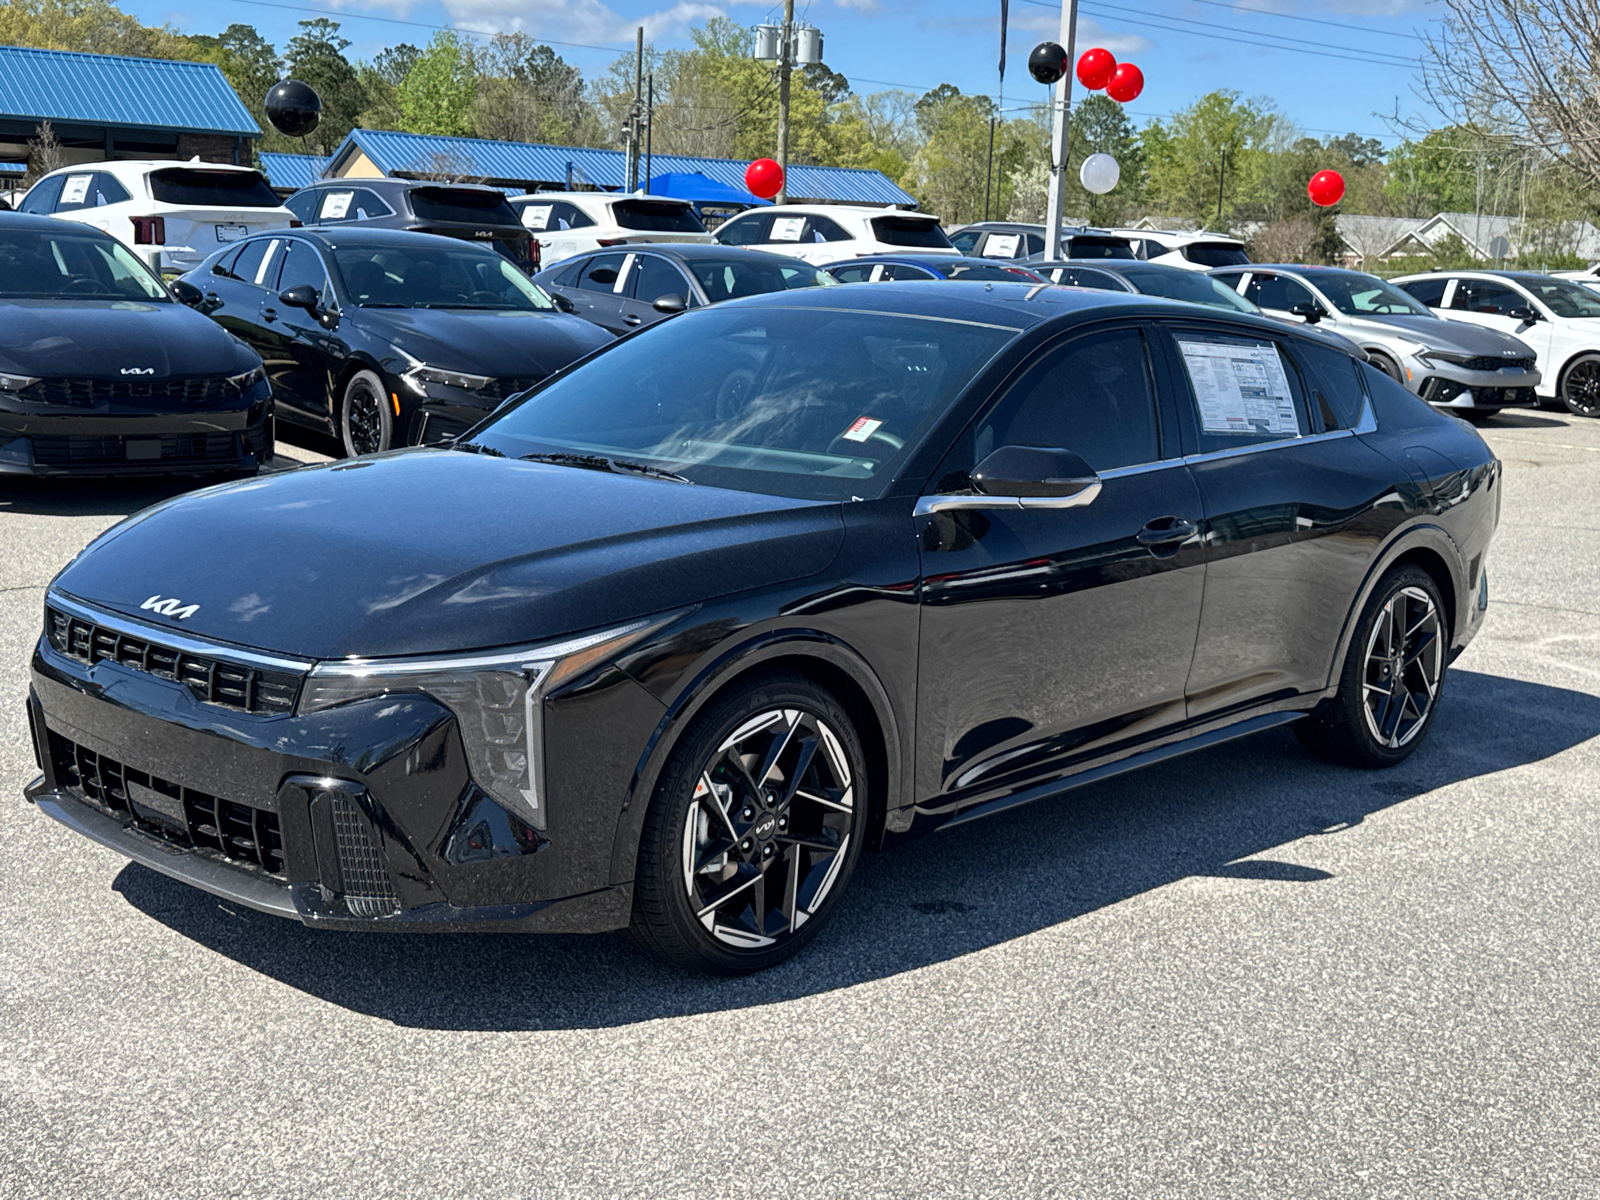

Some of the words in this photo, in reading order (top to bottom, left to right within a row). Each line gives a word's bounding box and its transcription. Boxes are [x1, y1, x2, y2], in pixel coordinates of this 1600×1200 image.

[120, 367, 155, 375] KIA
[140, 594, 201, 620] KIA
[665, 778, 690, 858] KUMHO
[755, 818, 776, 835] KIA
